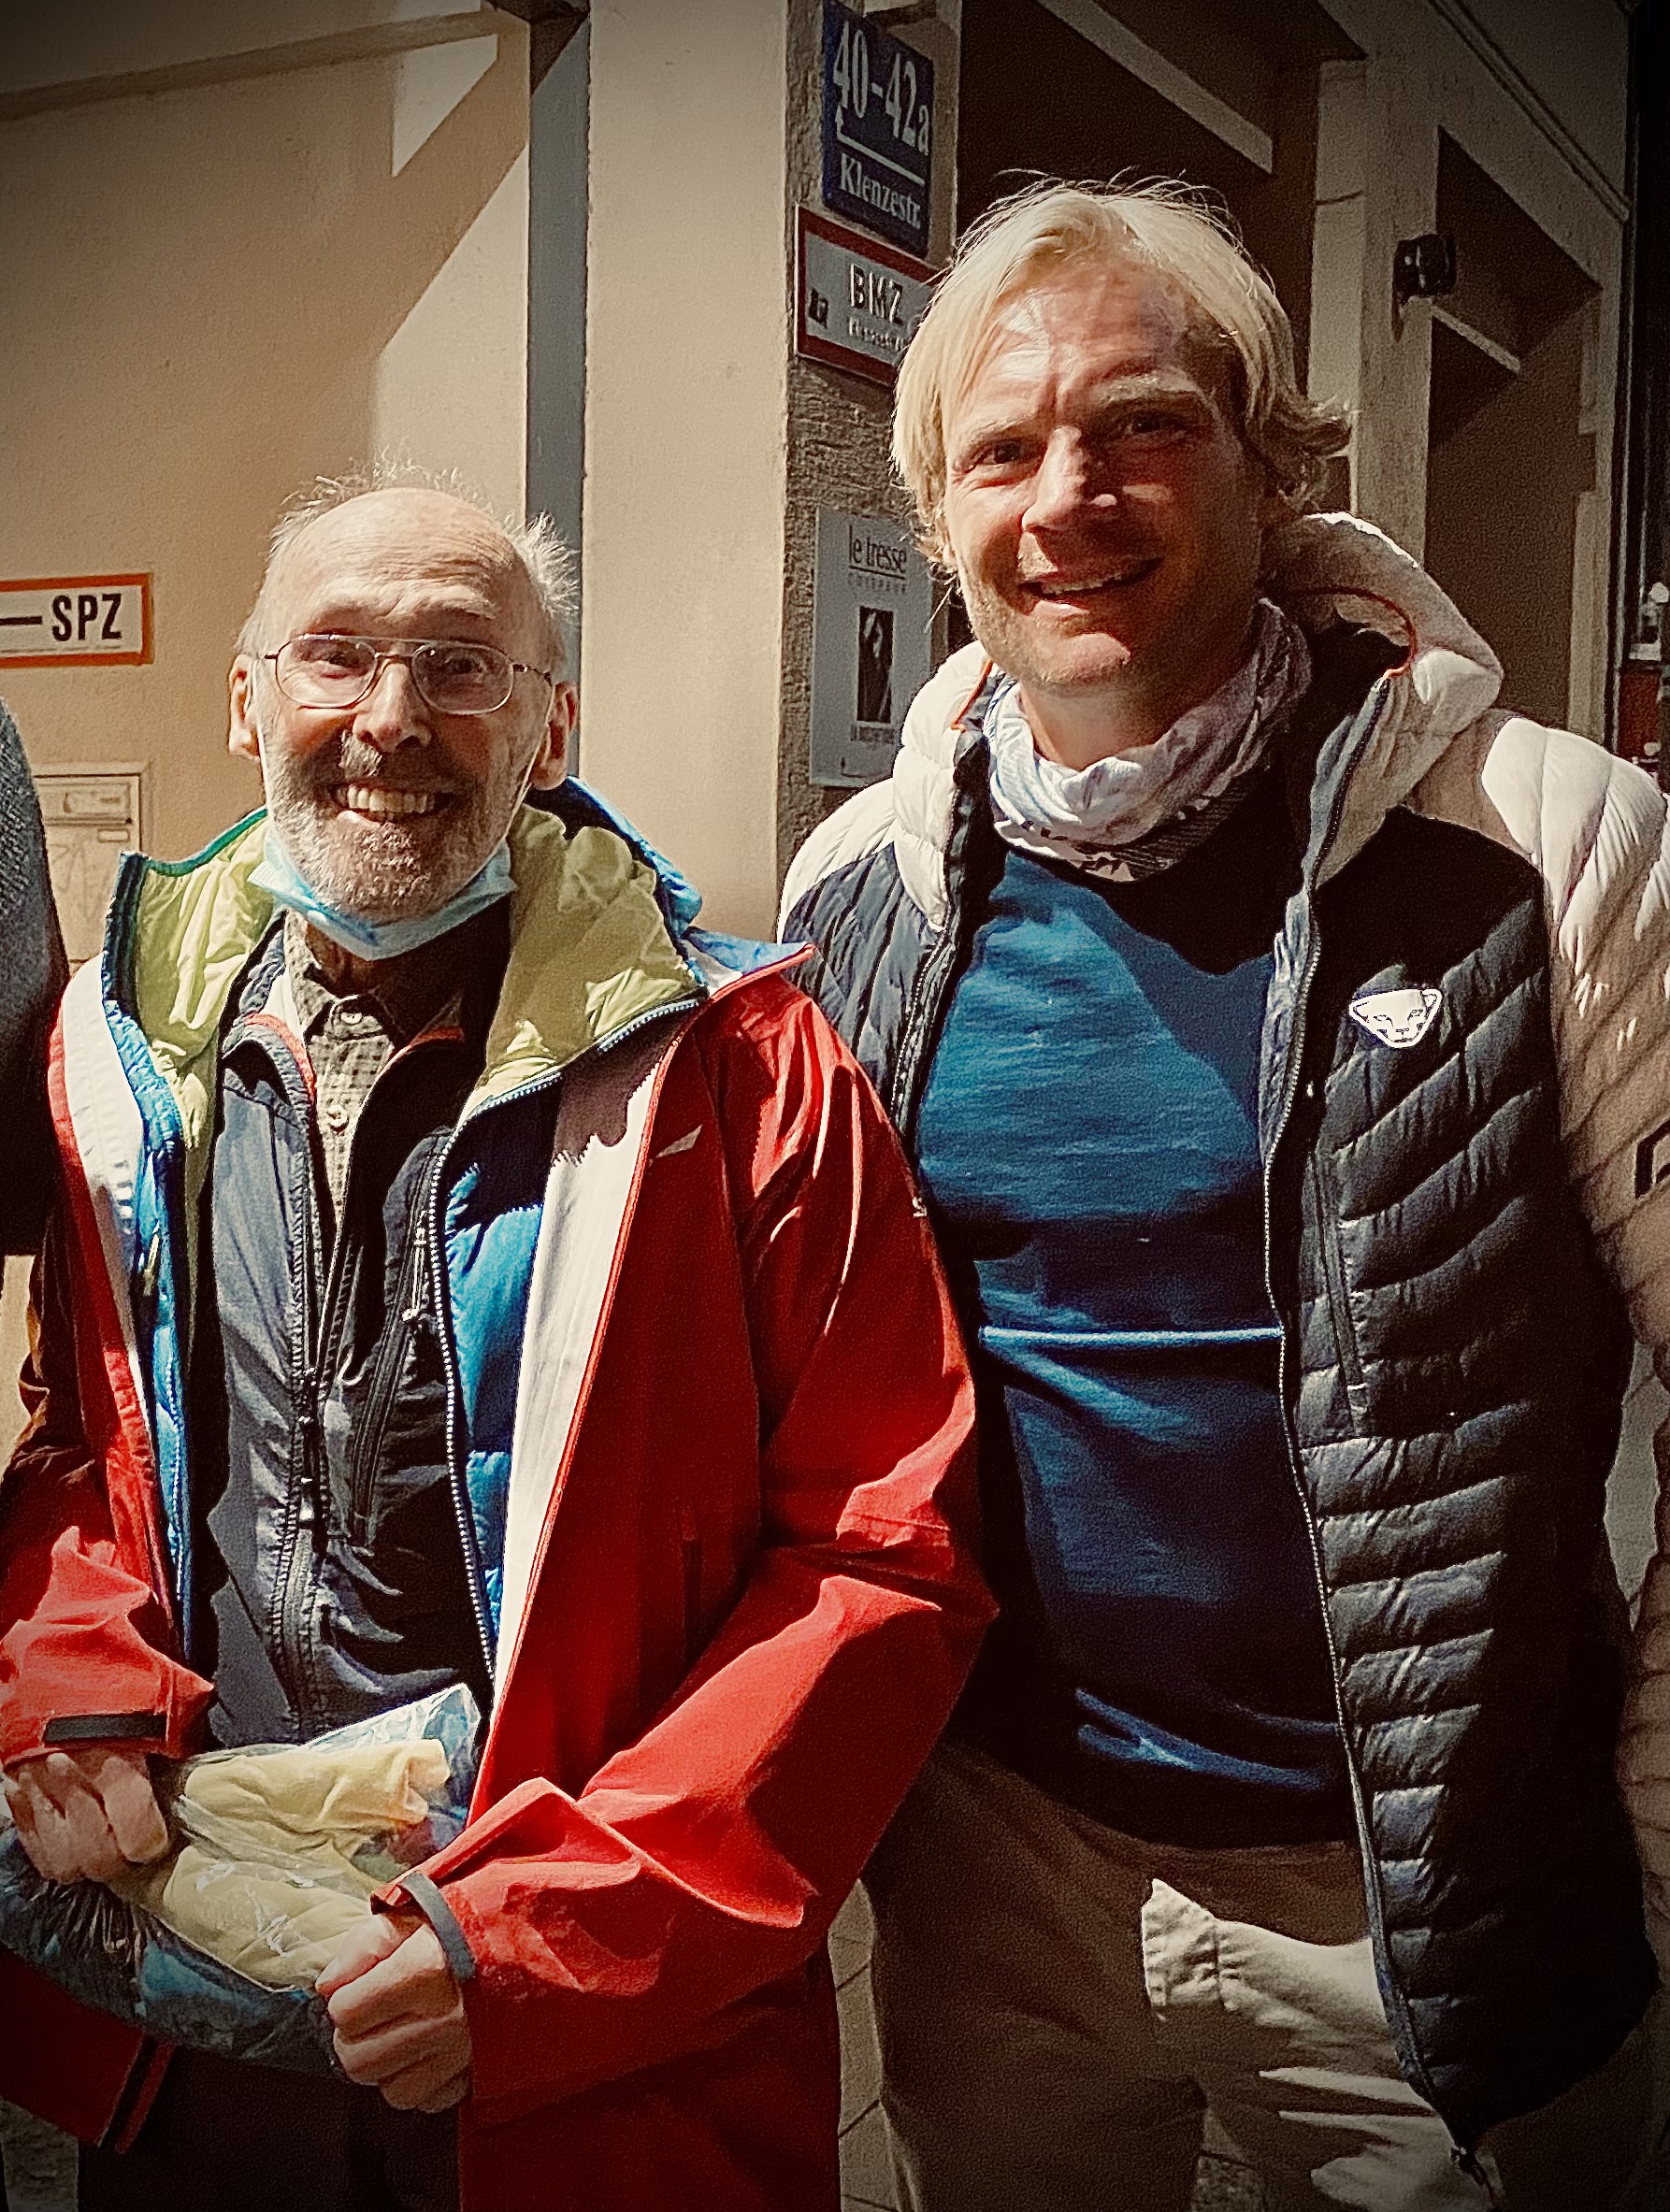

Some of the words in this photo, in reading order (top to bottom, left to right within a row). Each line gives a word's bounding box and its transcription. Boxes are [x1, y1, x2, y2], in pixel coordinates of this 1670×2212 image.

[832, 21, 929, 156] 40-42a
[848, 524, 862, 564] le
[866, 536, 907, 574] tresse
[51, 593, 122, 642] SPZ
